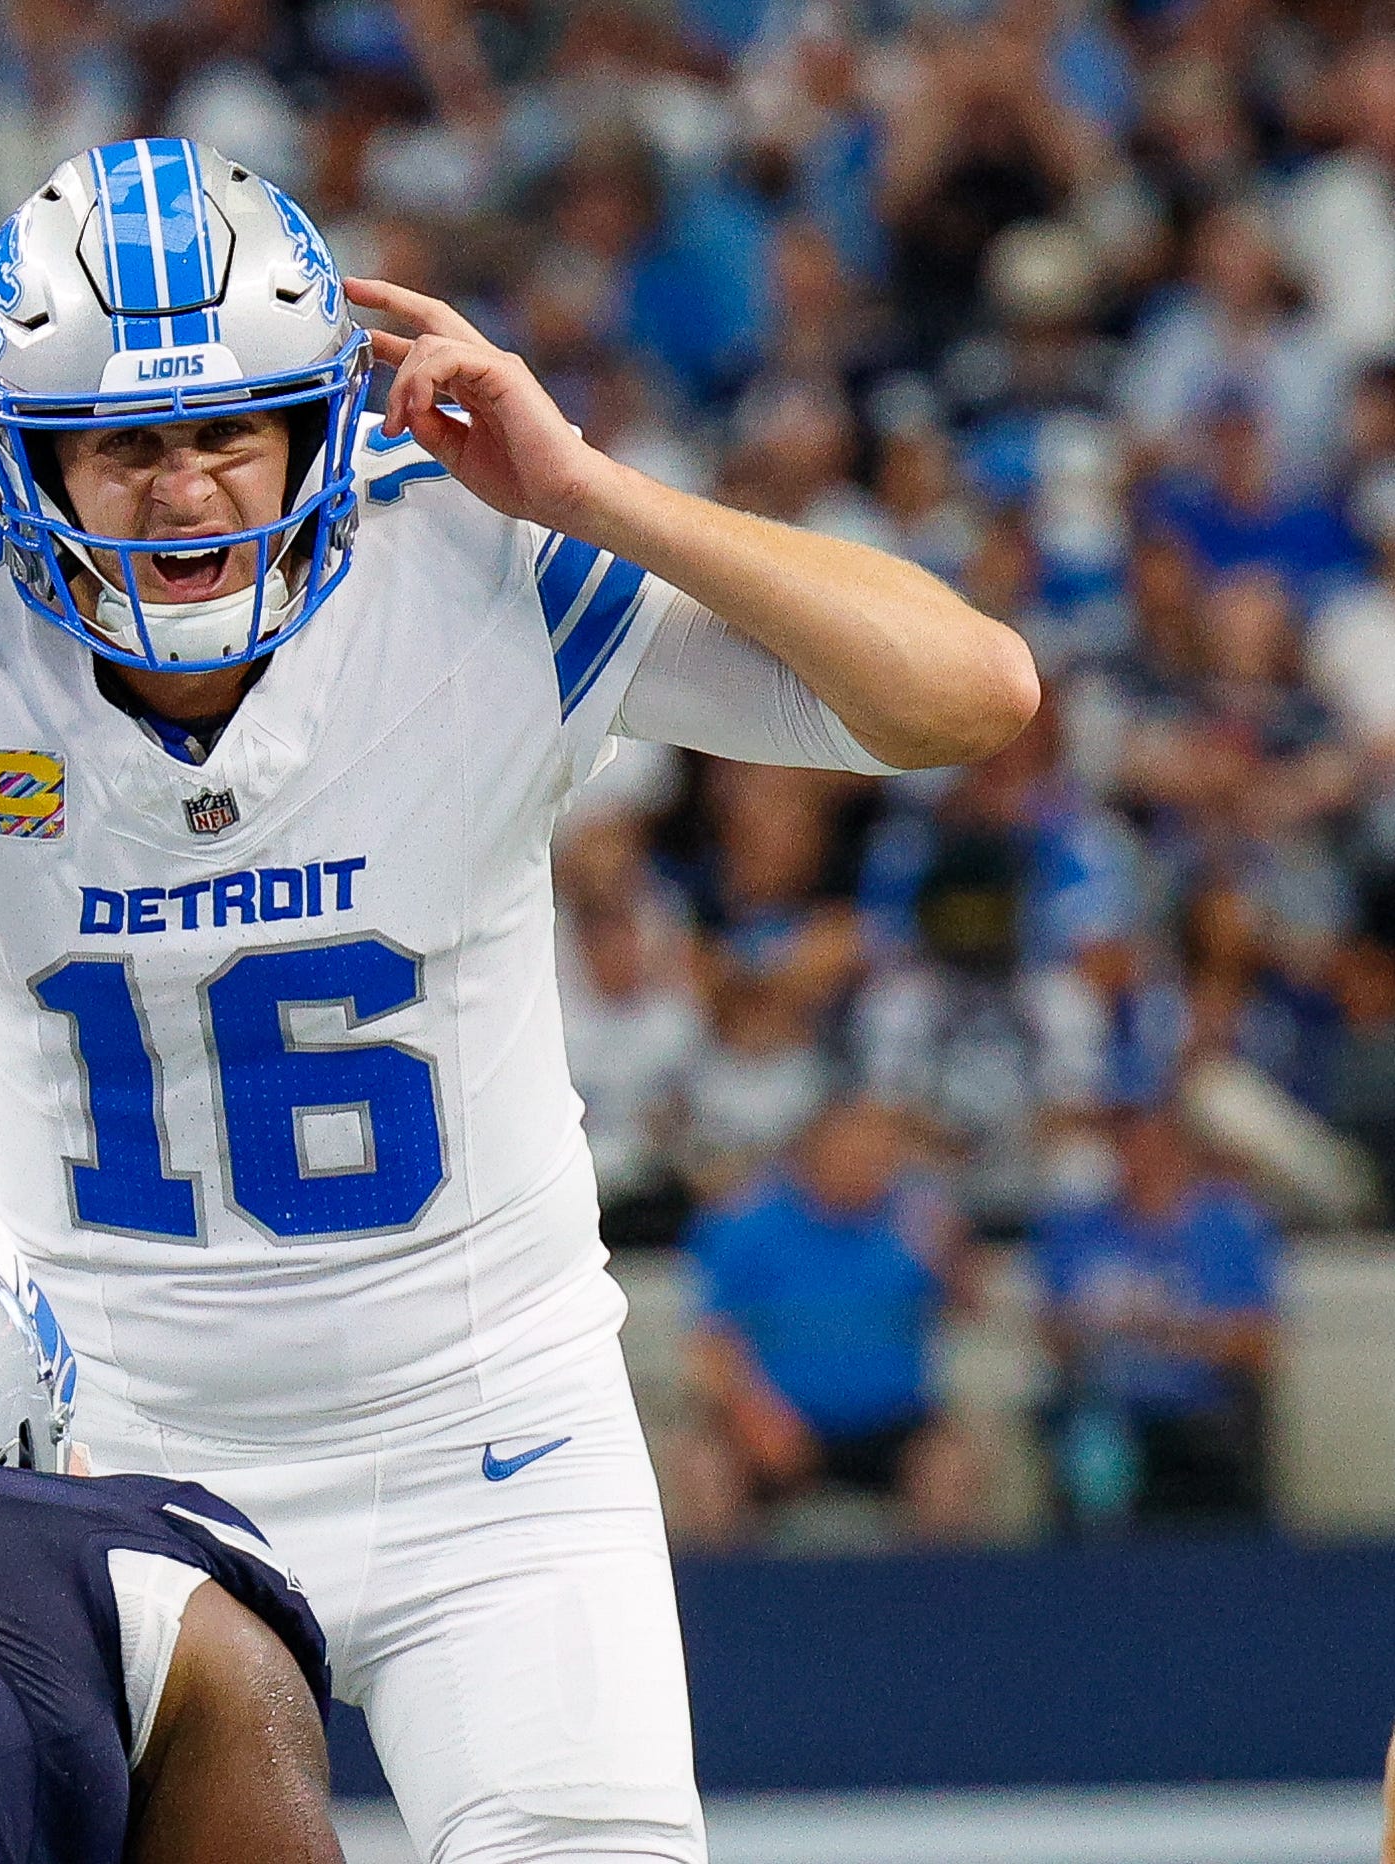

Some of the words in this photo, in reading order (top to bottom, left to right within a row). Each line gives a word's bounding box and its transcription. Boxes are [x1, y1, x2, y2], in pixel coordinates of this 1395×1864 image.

[137, 354, 205, 381] LIONS
[194, 808, 233, 831] NFL
[79, 857, 366, 935] DETROIT
[26, 929, 452, 1249] 16
